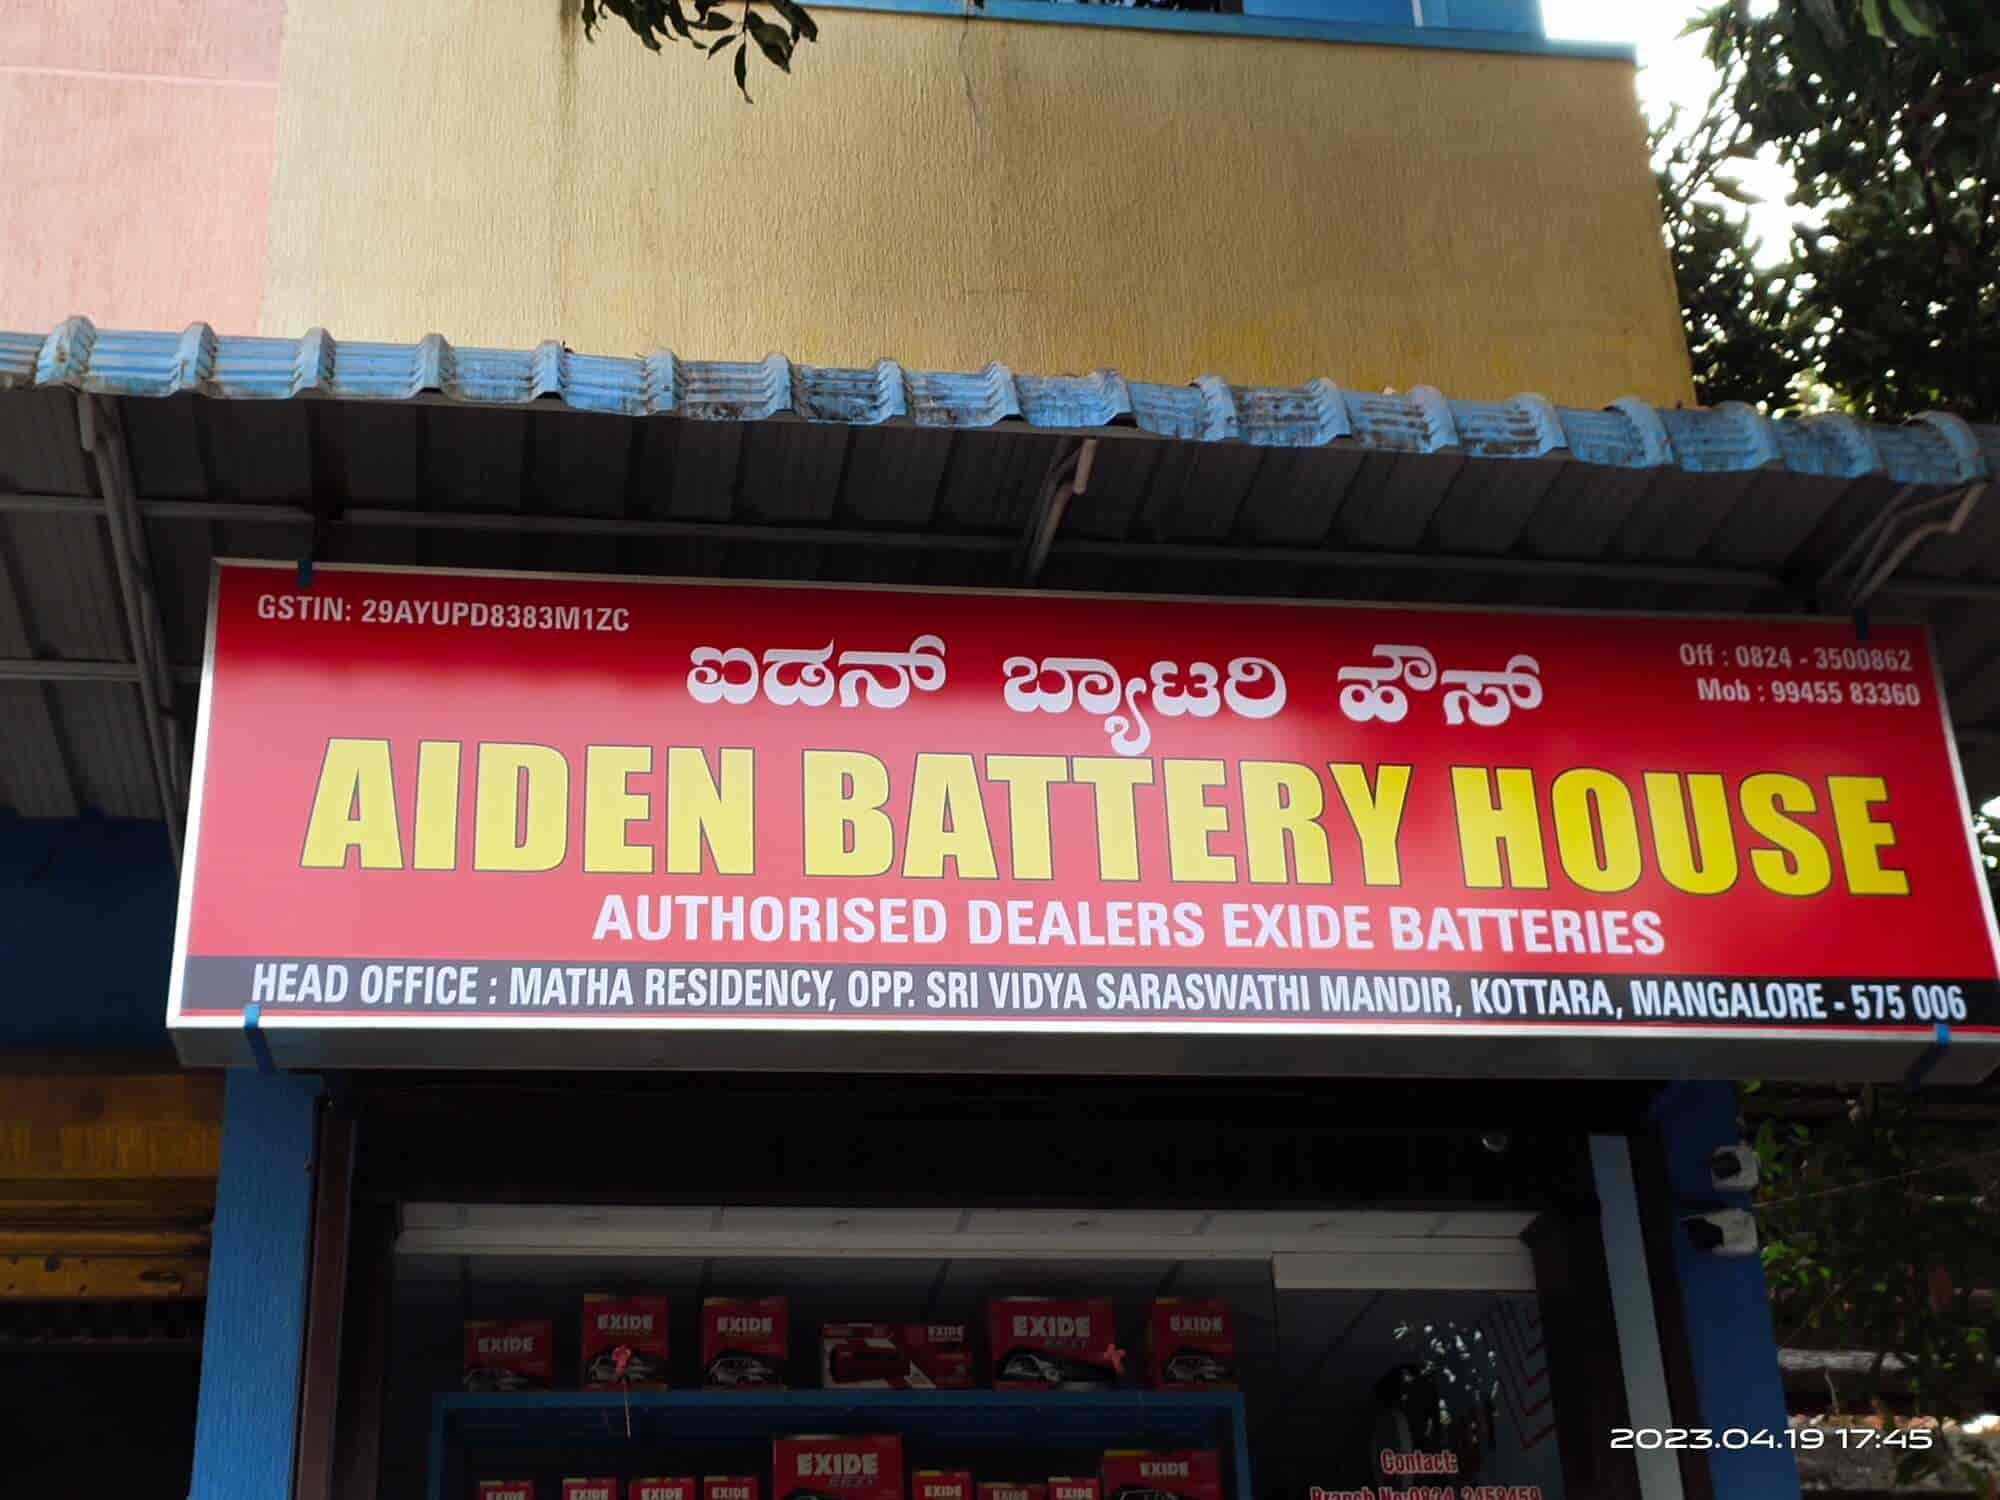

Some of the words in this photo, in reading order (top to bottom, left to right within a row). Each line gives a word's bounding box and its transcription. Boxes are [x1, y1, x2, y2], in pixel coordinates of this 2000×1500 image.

[257, 594, 352, 622] GSTIN:
[361, 599, 630, 632] 29AYUPD8383M1ZC
[1679, 642, 1713, 666] Off
[1735, 646, 1792, 669] 0824
[1813, 647, 1912, 672] 3500862
[686, 634, 947, 708] ಐಡನ್
[1002, 656, 1287, 757] ಬ್ಯಾಟರಿ
[1337, 643, 1543, 727] ಹೌಸ್
[1697, 678, 1750, 701] Mob
[1771, 680, 1843, 704] 99455
[1850, 682, 1920, 707] 83360
[300, 738, 756, 876] AIDEN
[802, 748, 1413, 887] BATTERY
[1451, 766, 1911, 898] HOUSE
[592, 894, 947, 944] AUTHORISED
[968, 899, 1206, 947] DEALERS
[1222, 903, 1375, 950] EXIDE
[1389, 906, 1665, 954] BATTERIES
[252, 962, 349, 1003] HEAD
[360, 965, 479, 1005] OFFICE
[509, 967, 634, 1007] MATHA
[644, 968, 838, 1012] RESIDENCY,
[847, 971, 916, 1008] OPP.
[926, 972, 979, 1009] SRI
[987, 972, 1088, 1010] VIDYA
[1096, 973, 1311, 1011] SARASWATHI
[1319, 976, 1463, 1018] MANDIR,
[1470, 977, 1623, 1021] KOTTARA,
[1630, 981, 1828, 1019] MANGALORE
[1853, 984, 1903, 1020] 575
[1911, 985, 1967, 1021] 006
[597, 1314, 655, 1331] EXIDE
[716, 1316, 774, 1333] EXIDE
[1012, 1315, 1091, 1338] EXIDE
[1169, 1314, 1224, 1333] EXIDE
[477, 1336, 535, 1353] EXIDE
[796, 1453, 880, 1477] EXIDE
[1139, 1461, 1190, 1478] EXIDE
[923, 1485, 964, 1498] EXIDE
[1055, 1487, 1094, 1499] EXIDE
